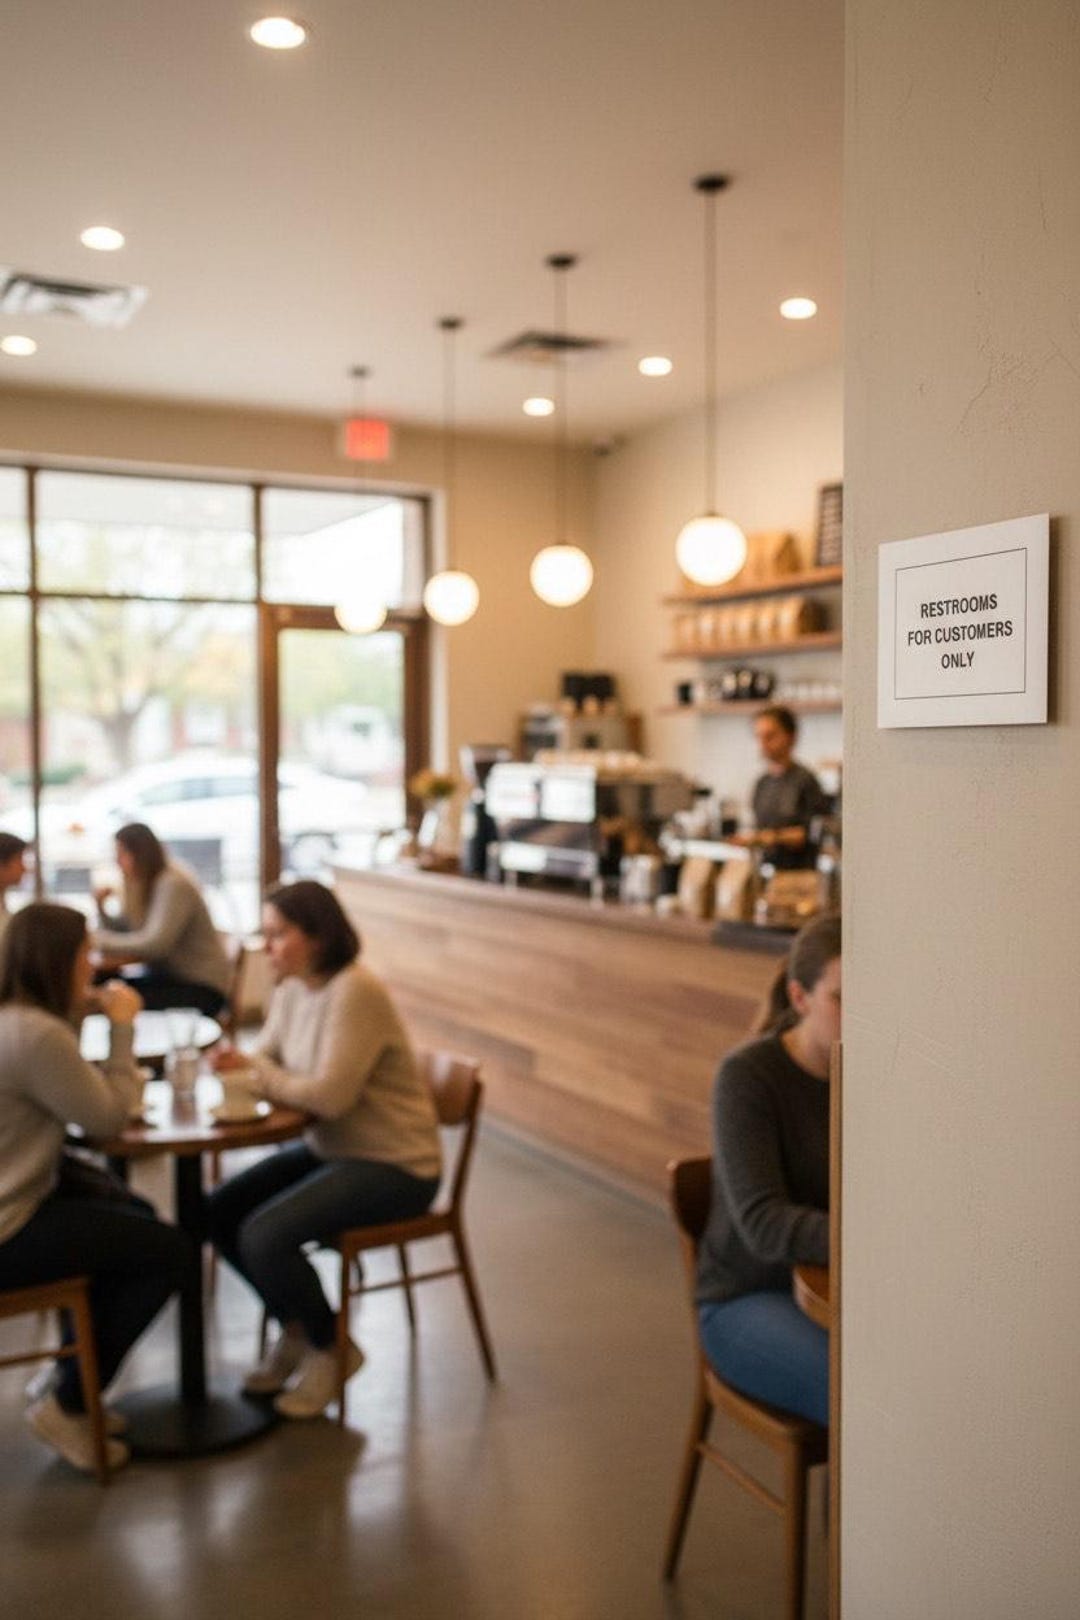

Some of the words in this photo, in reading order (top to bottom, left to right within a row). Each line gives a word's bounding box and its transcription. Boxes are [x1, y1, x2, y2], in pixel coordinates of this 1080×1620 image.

[920, 593, 998, 619] RESTROOMS
[907, 630, 932, 646] FOR
[935, 620, 1013, 644] CUSTOMERS
[941, 651, 975, 669] ONLY
